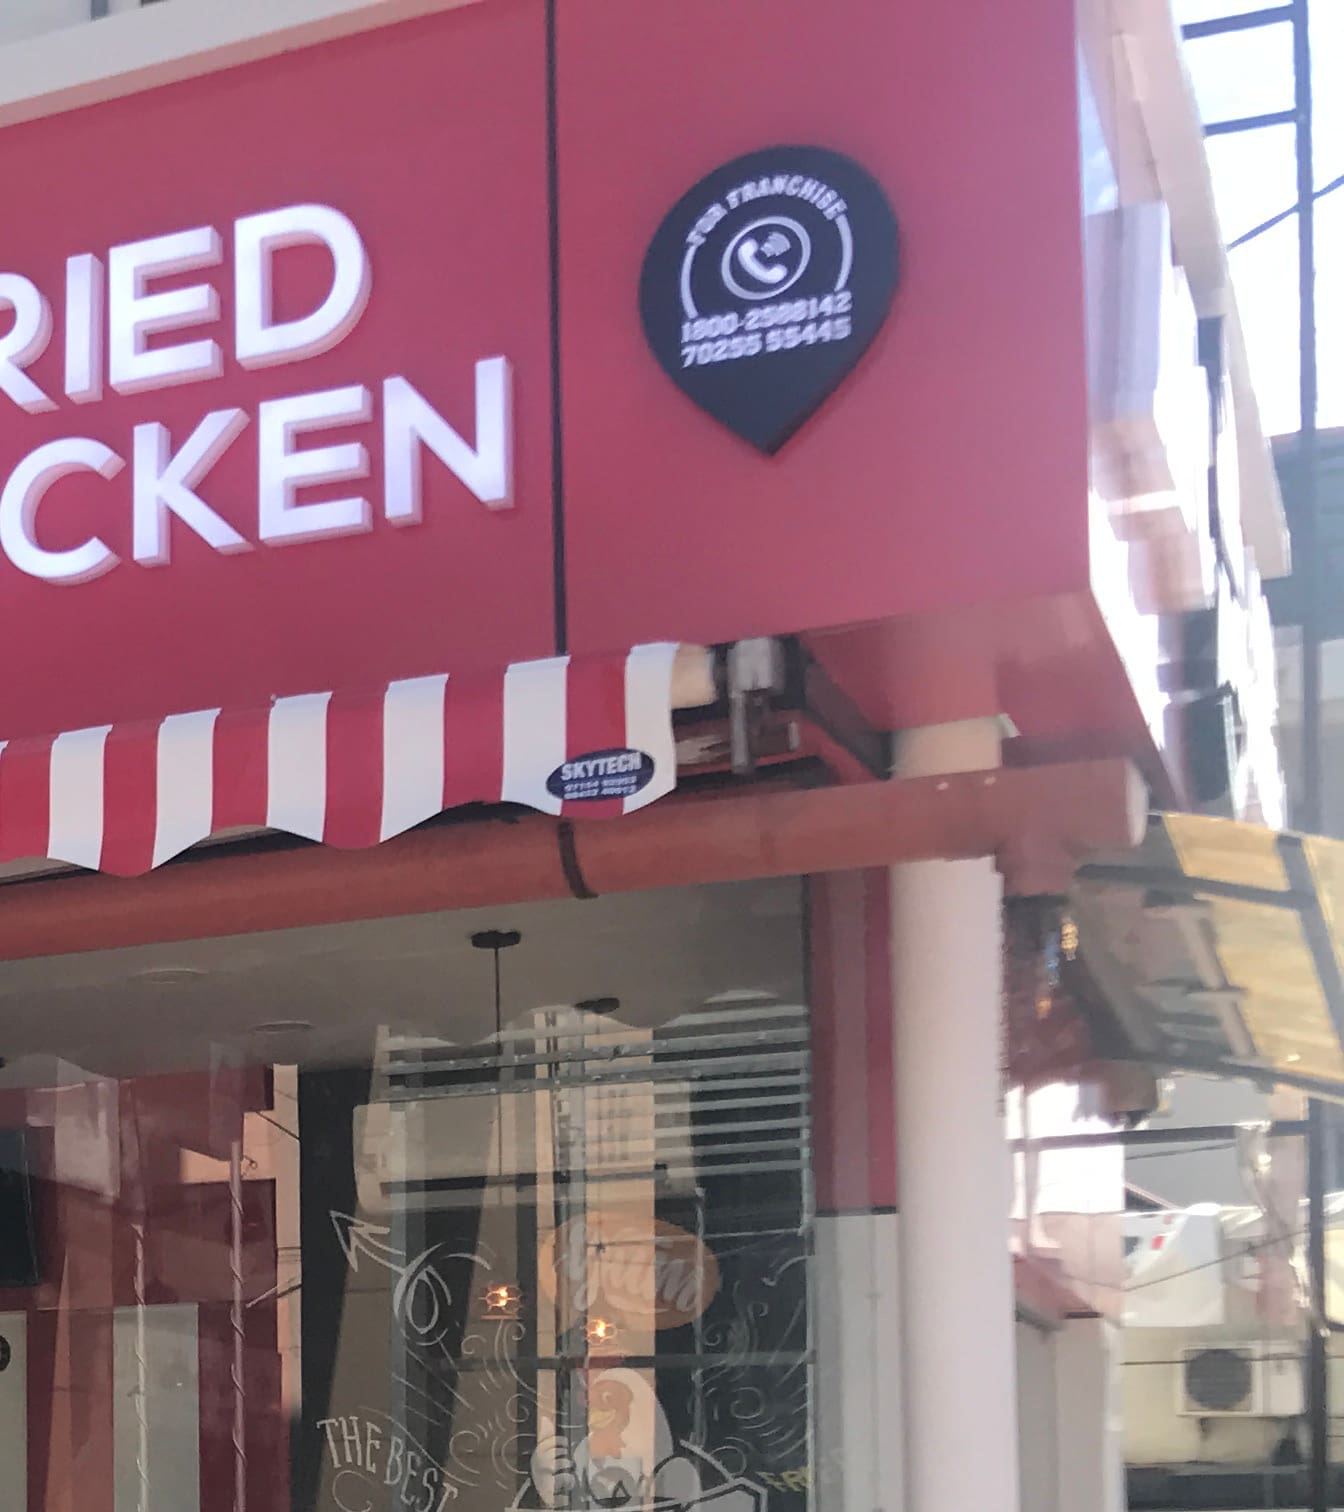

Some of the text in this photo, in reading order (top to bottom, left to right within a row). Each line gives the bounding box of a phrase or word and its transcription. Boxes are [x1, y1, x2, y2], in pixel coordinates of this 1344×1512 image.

[726, 174, 848, 220] FRANCHISE
[561, 752, 642, 780] SKYTECH
[316, 1416, 383, 1474] THE
